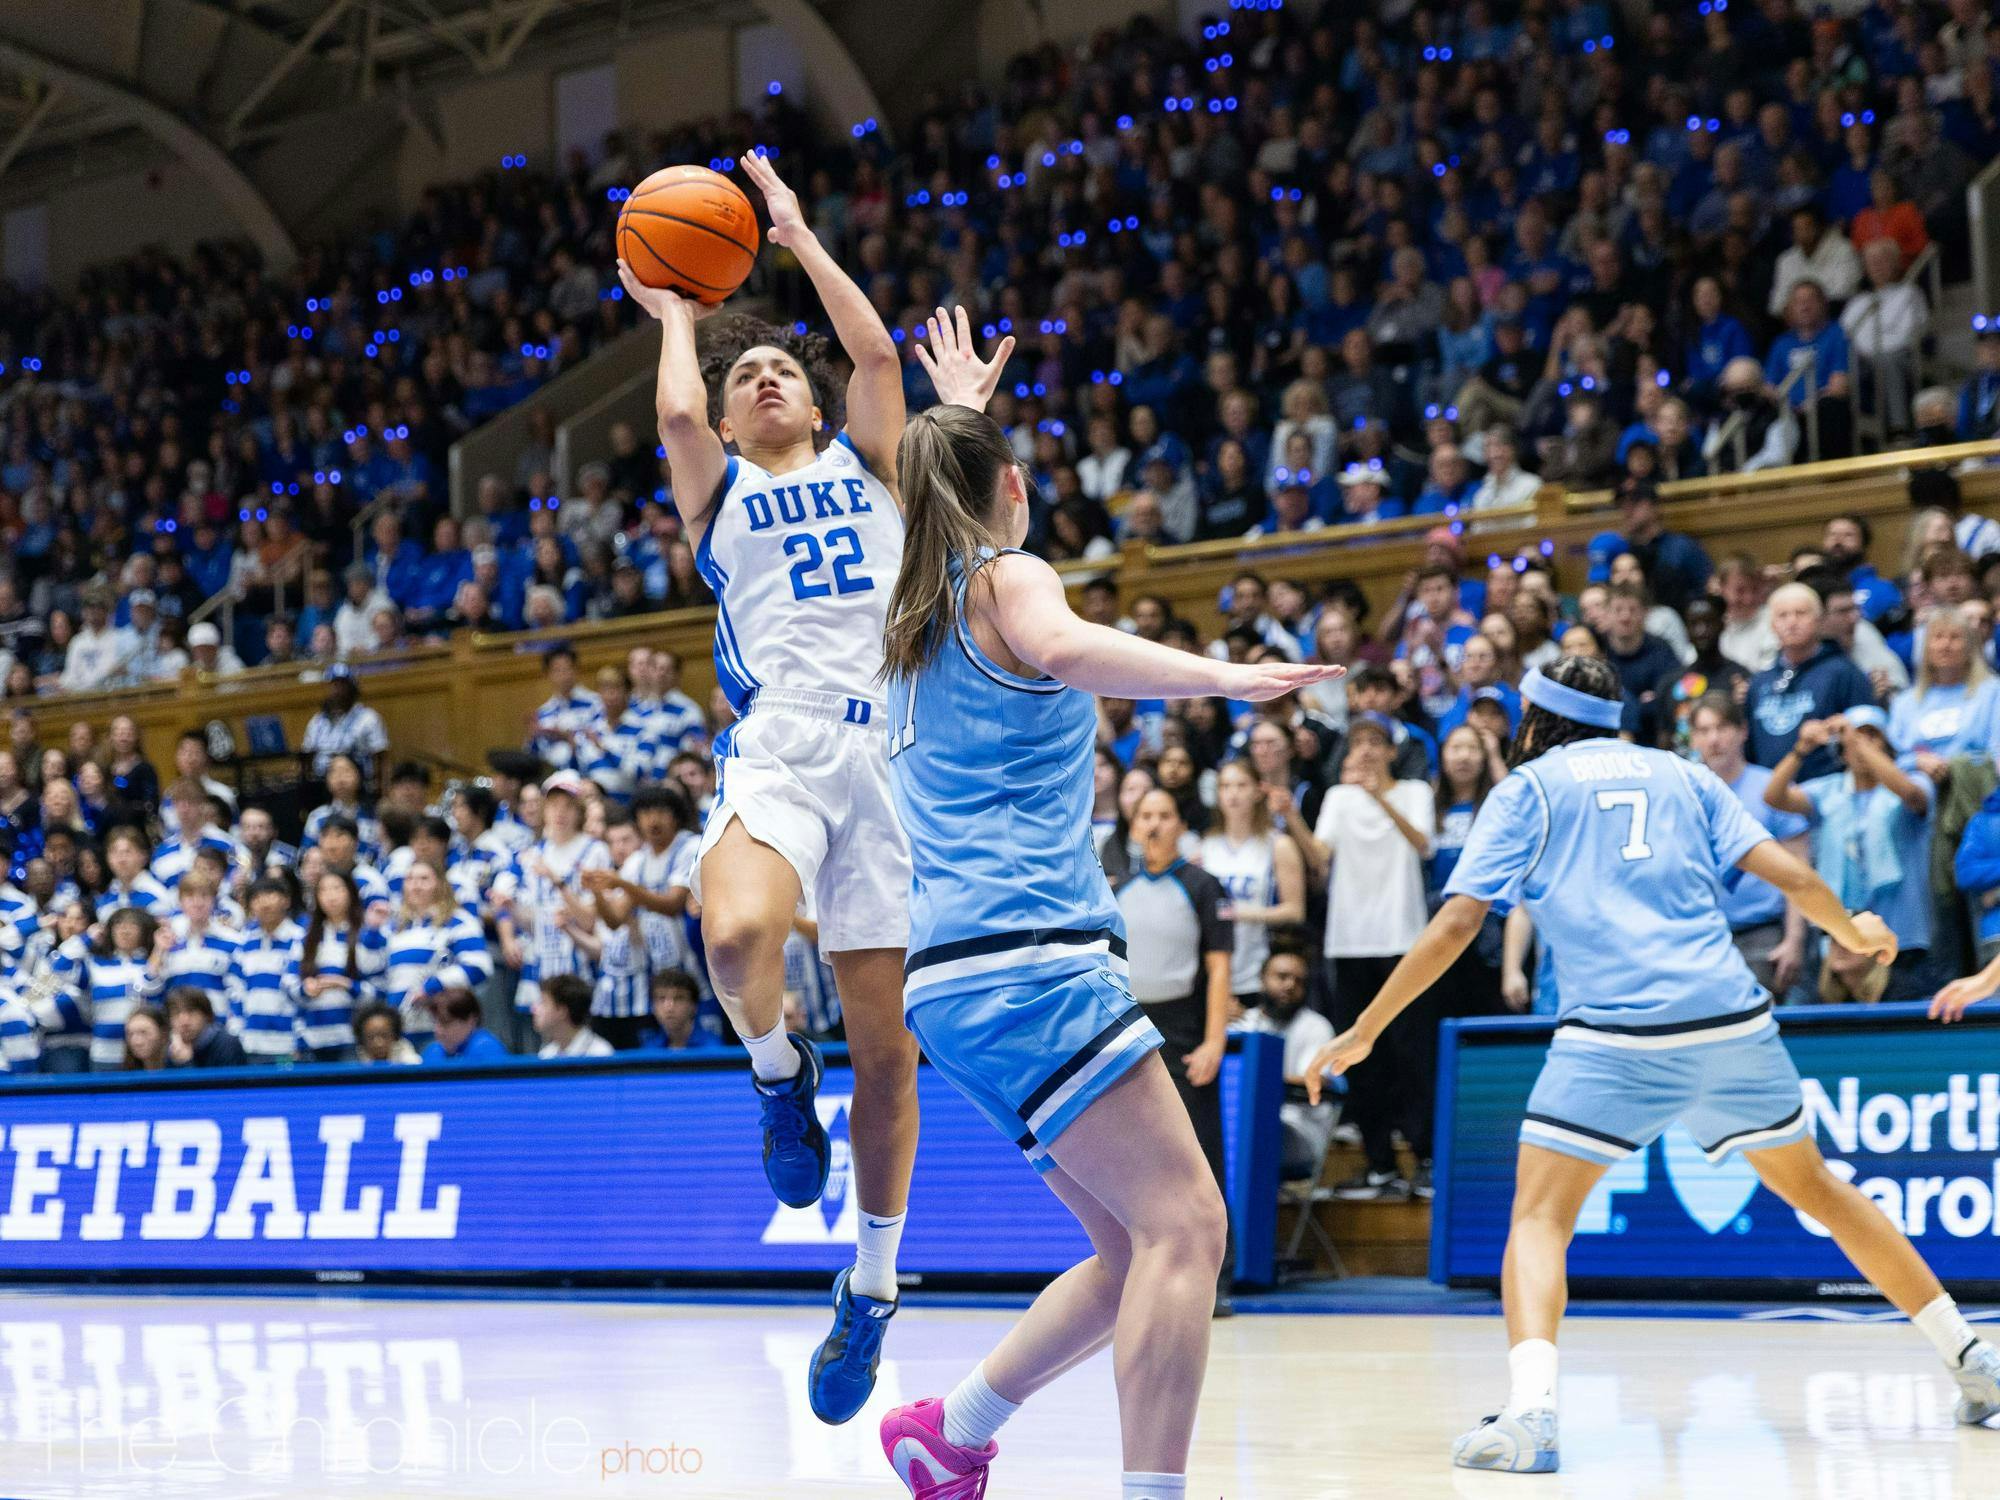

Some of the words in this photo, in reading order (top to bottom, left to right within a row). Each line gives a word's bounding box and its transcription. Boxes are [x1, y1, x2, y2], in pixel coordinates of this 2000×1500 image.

[741, 478, 873, 532] DUKE
[783, 526, 875, 601] 22
[1567, 752, 1653, 783] BROOKS
[1595, 787, 1654, 862] 7
[0, 1113, 461, 1241] ETBALL
